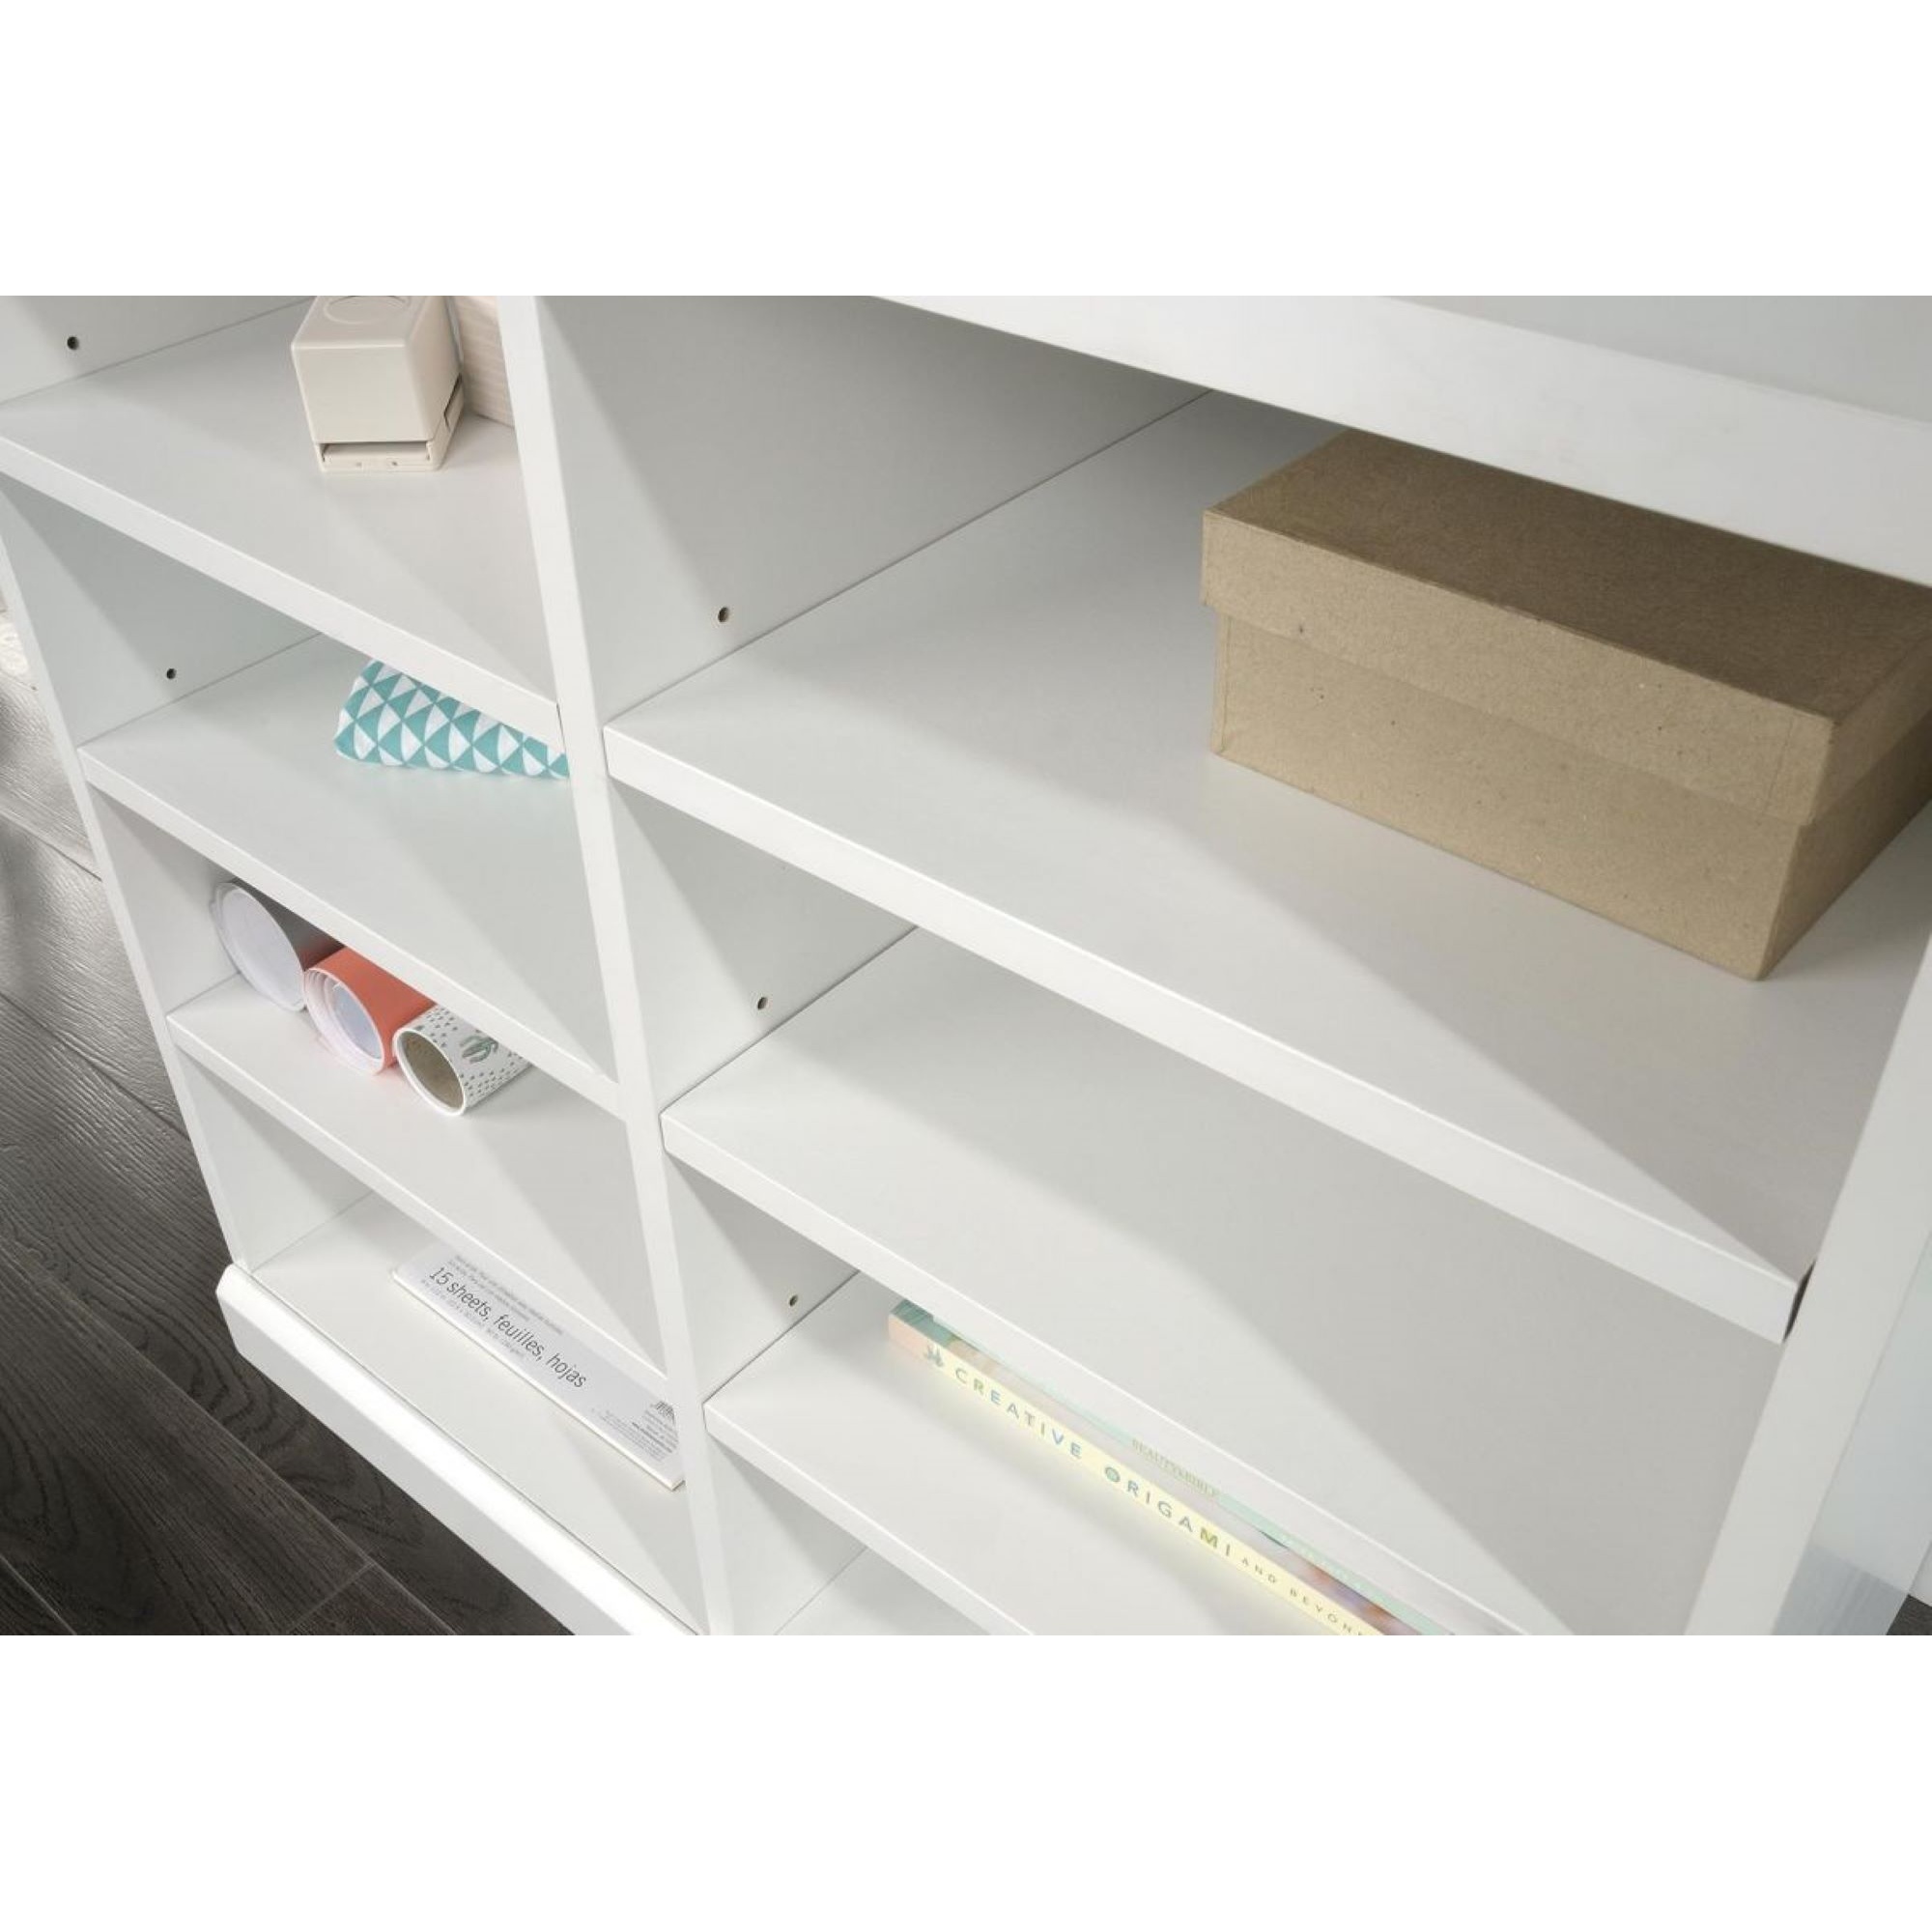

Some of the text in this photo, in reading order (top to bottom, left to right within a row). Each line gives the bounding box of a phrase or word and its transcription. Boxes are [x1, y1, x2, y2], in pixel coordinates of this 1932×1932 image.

[429, 1266, 454, 1286] 15
[446, 1281, 492, 1321] sheets,
[494, 1314, 545, 1362] feuilles,
[545, 1352, 586, 1388] hojas
[954, 1367, 1082, 1460] CREATIVE
[1104, 1465, 1231, 1557] ORIGAMI
[1241, 1556, 1277, 1584] AND
